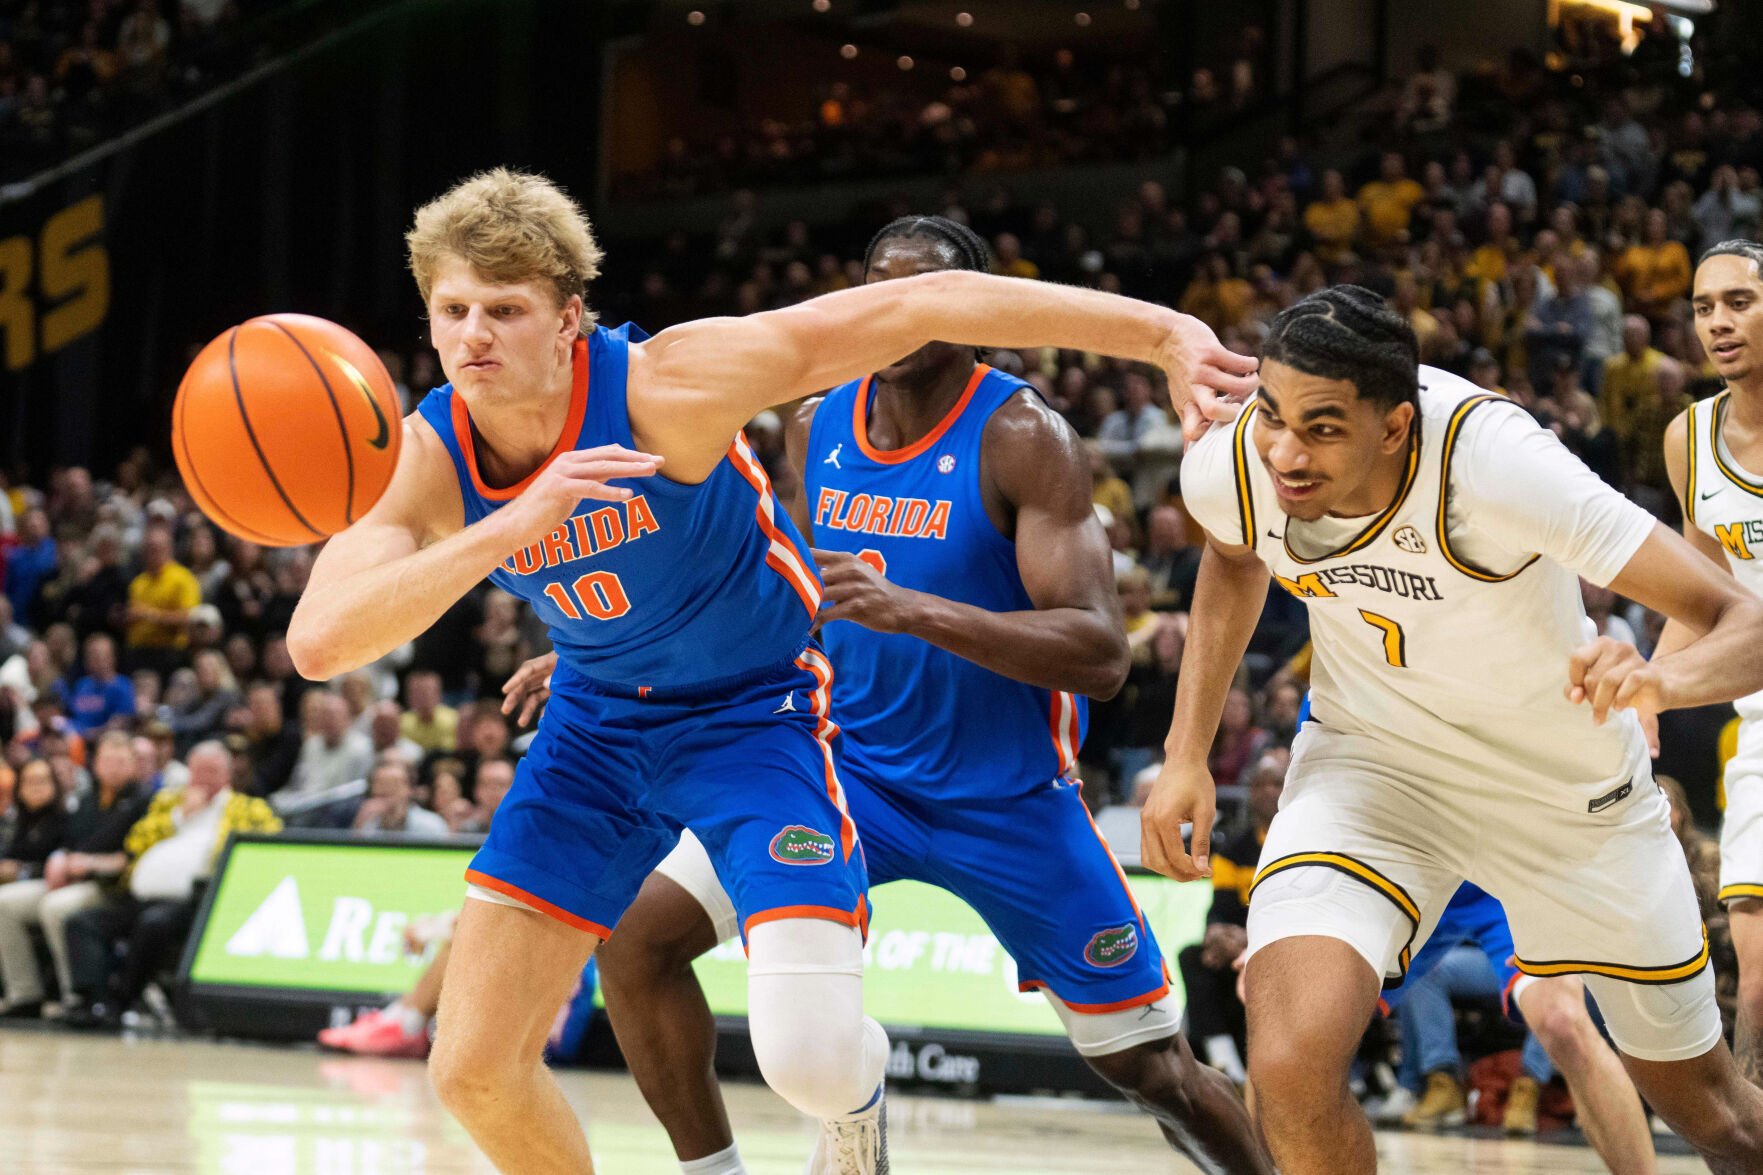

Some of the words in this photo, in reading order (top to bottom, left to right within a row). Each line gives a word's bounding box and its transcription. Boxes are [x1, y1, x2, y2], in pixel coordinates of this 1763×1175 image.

[500, 495, 660, 577] ORIDA
[815, 486, 953, 540] FLORIDA
[543, 570, 631, 620] 10
[1273, 564, 1445, 600] MISSOURI
[1357, 607, 1408, 668] 7
[918, 1043, 980, 1082] Care
